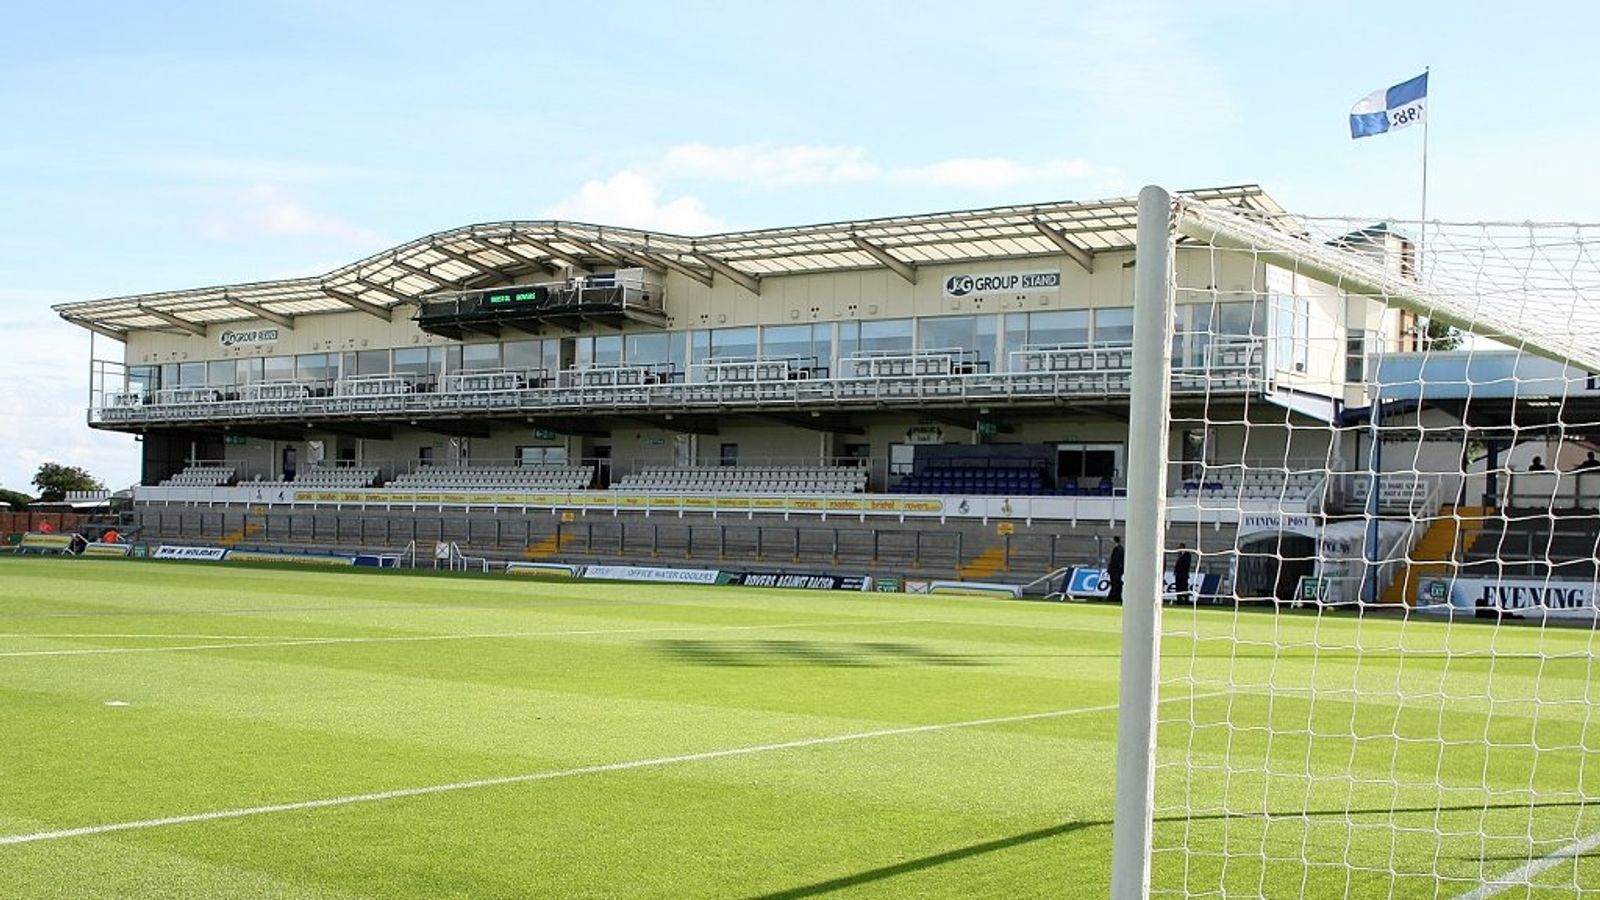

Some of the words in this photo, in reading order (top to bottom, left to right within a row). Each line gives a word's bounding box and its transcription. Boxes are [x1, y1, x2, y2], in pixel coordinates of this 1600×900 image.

[975, 275, 1019, 291] GROUP
[1022, 274, 1058, 288] STAND
[1287, 517, 1309, 526] POST
[1304, 586, 1325, 597] EXT
[1483, 587, 1583, 609] EVENING
